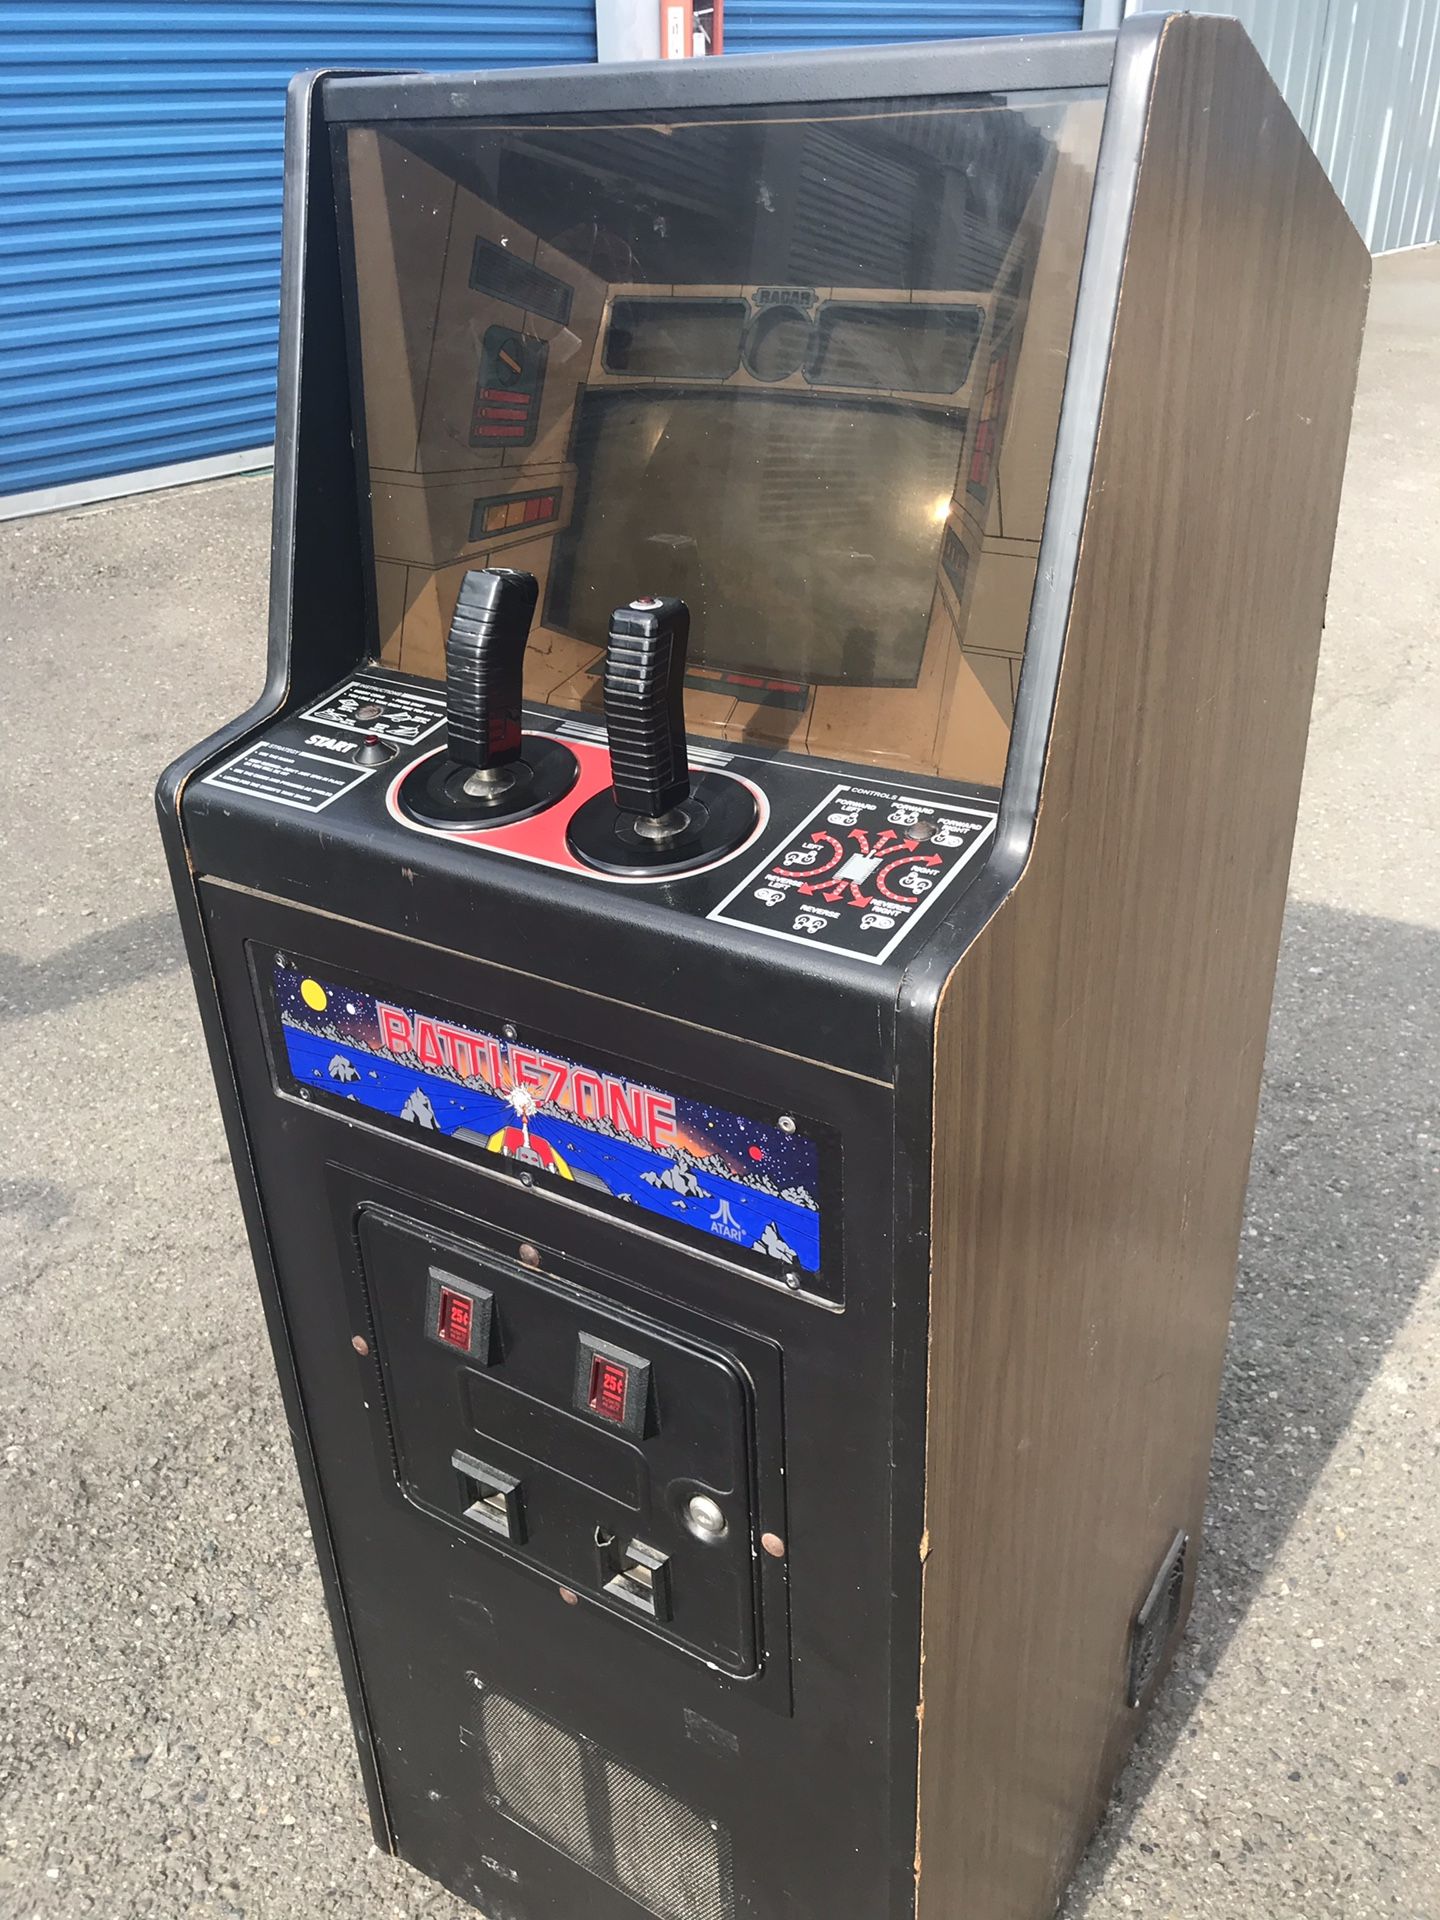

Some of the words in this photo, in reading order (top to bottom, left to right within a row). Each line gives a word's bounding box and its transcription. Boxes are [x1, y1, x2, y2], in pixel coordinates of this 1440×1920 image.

[304, 734, 359, 754] START
[850, 786, 898, 801] CONTROLS
[835, 797, 877, 812] FORWARD
[890, 801, 935, 816] FORWARD
[937, 817, 983, 831] FORWARD
[801, 842, 825, 852] LEFT
[910, 864, 941, 876] RIGHT
[764, 873, 804, 888] REVERSE
[799, 904, 841, 919] REVERSE
[870, 898, 913, 914] REVERSE
[376, 1000, 677, 1148] BATTLEZONE
[710, 1221, 742, 1242] ATARI
[451, 1307, 469, 1326] 25¢
[603, 1373, 623, 1394] 25¢
